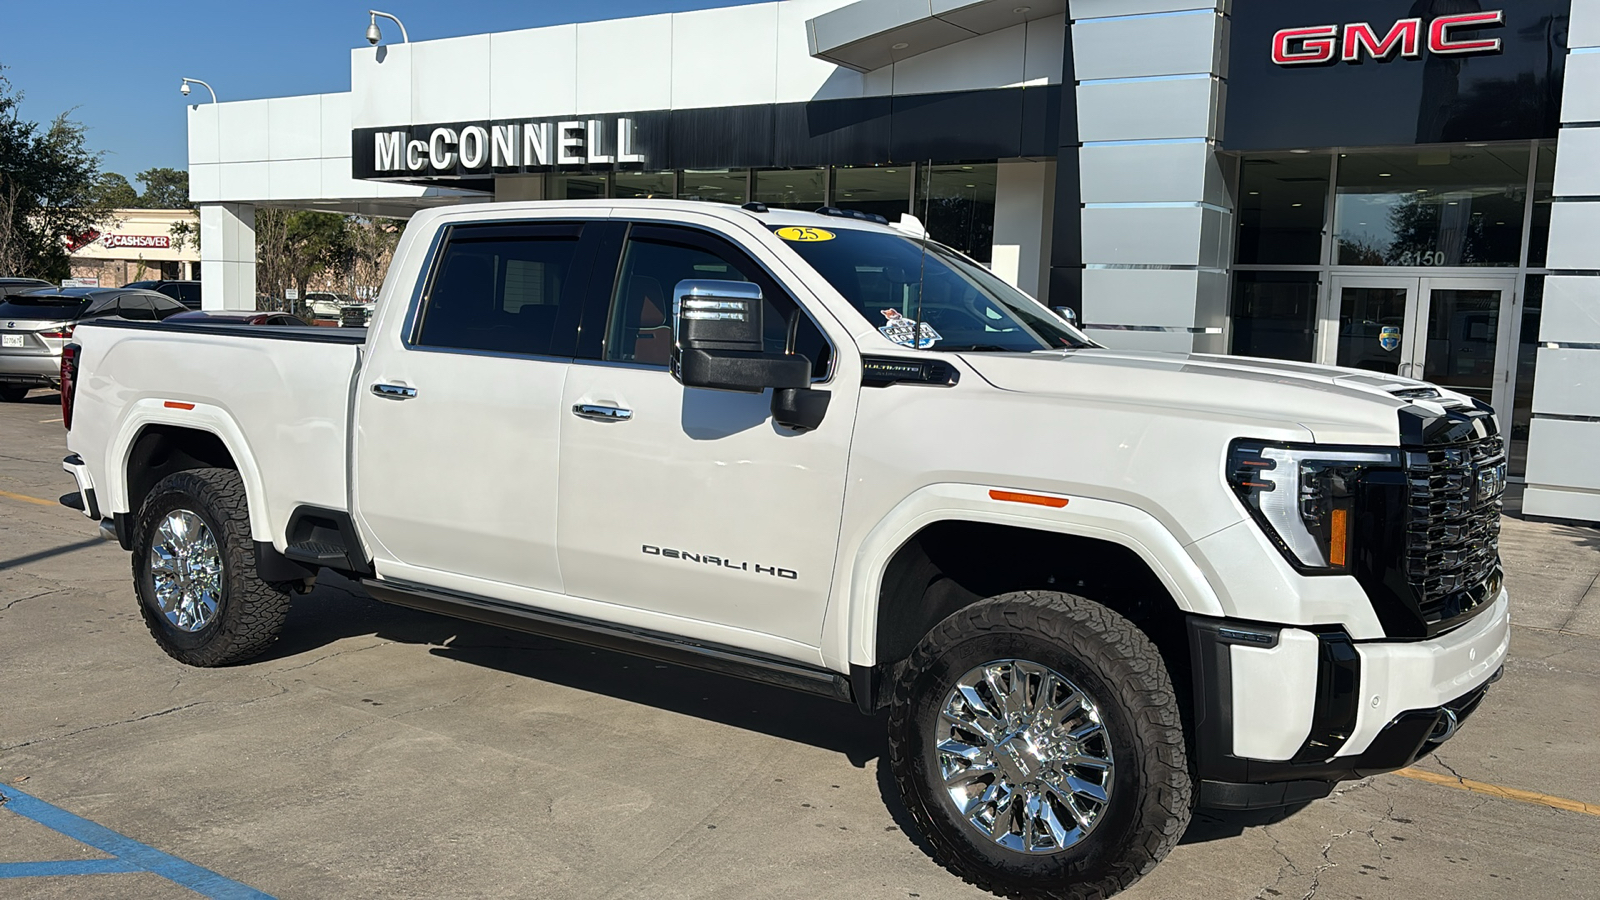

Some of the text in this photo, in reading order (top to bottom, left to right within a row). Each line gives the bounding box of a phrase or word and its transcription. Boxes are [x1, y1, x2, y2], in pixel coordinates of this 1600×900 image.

[1271, 9, 1504, 66] GMC
[791, 227, 820, 241] 25
[642, 544, 798, 580] DENALI HD
